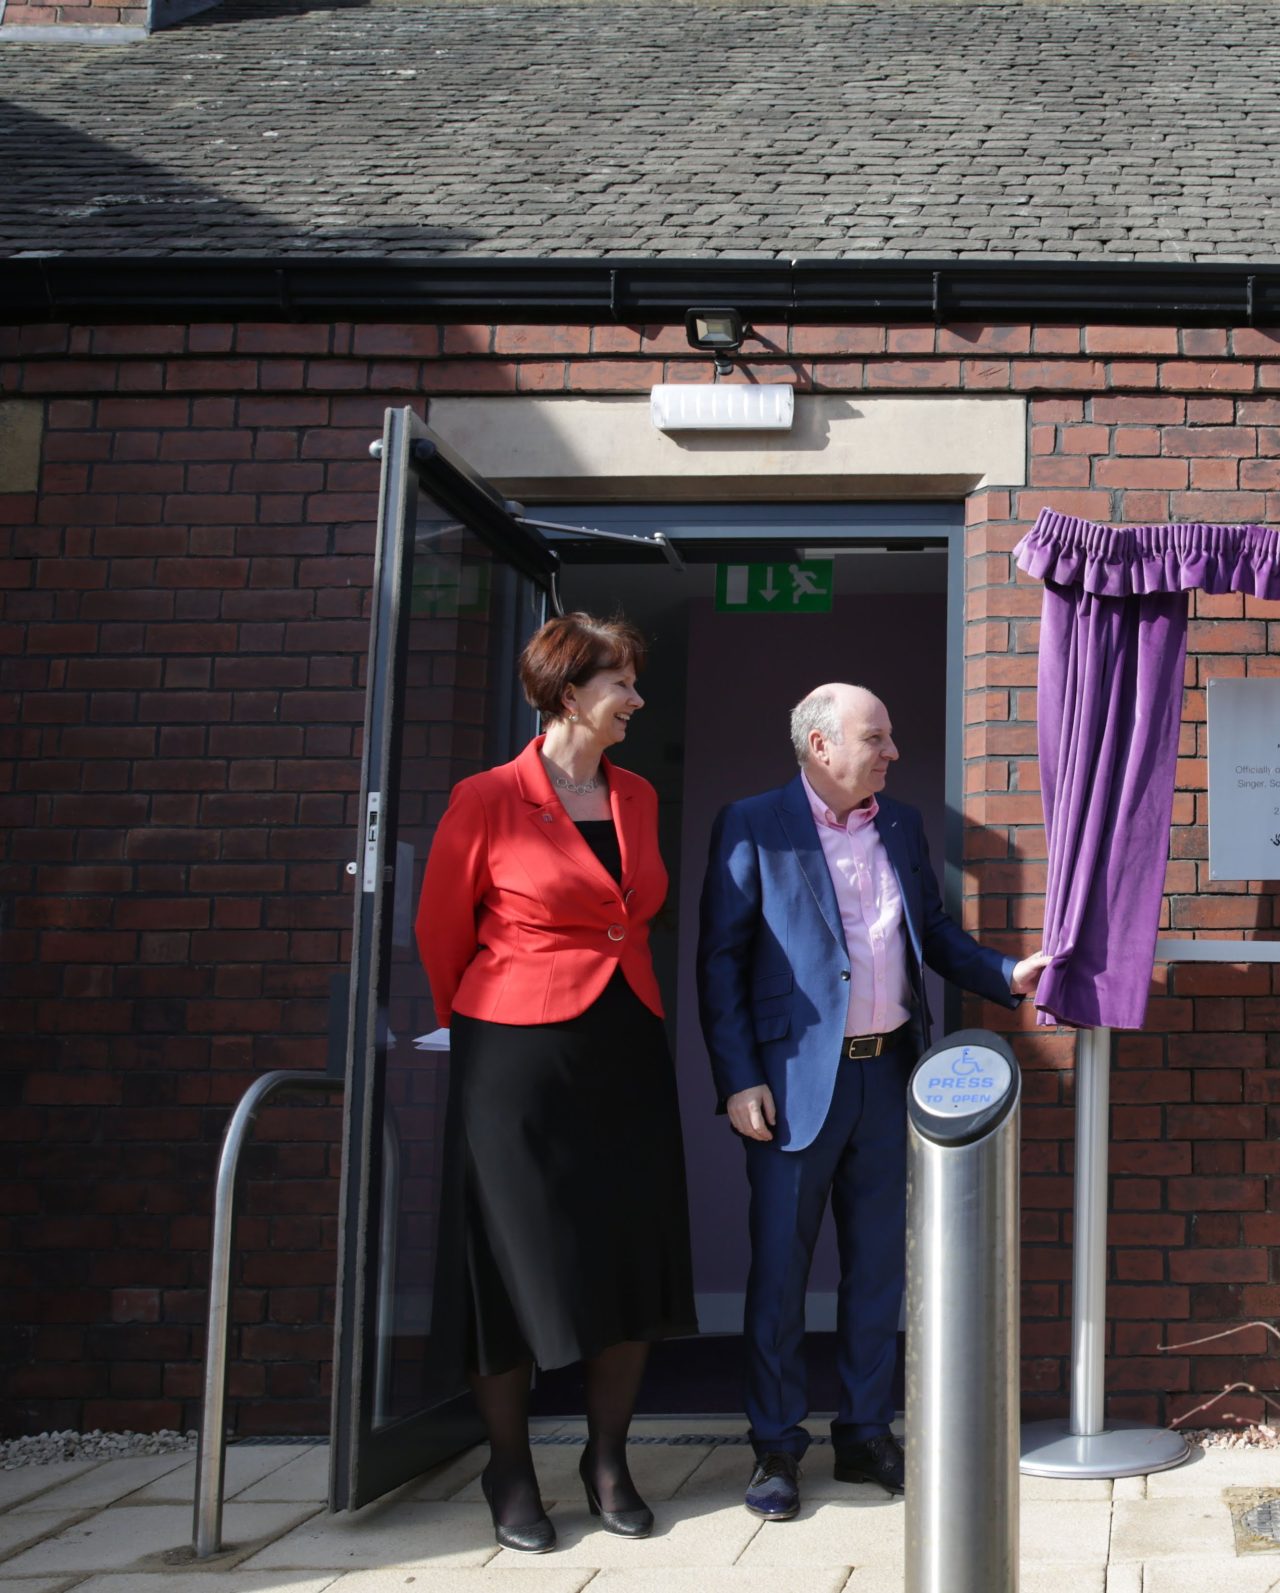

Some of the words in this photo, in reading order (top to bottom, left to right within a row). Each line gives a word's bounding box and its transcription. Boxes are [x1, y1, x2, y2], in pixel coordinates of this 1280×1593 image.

[1235, 765, 1270, 775] Officially
[928, 1077, 993, 1088] PRESS
[926, 1095, 943, 1103] TO
[952, 1094, 992, 1102] OPEN
